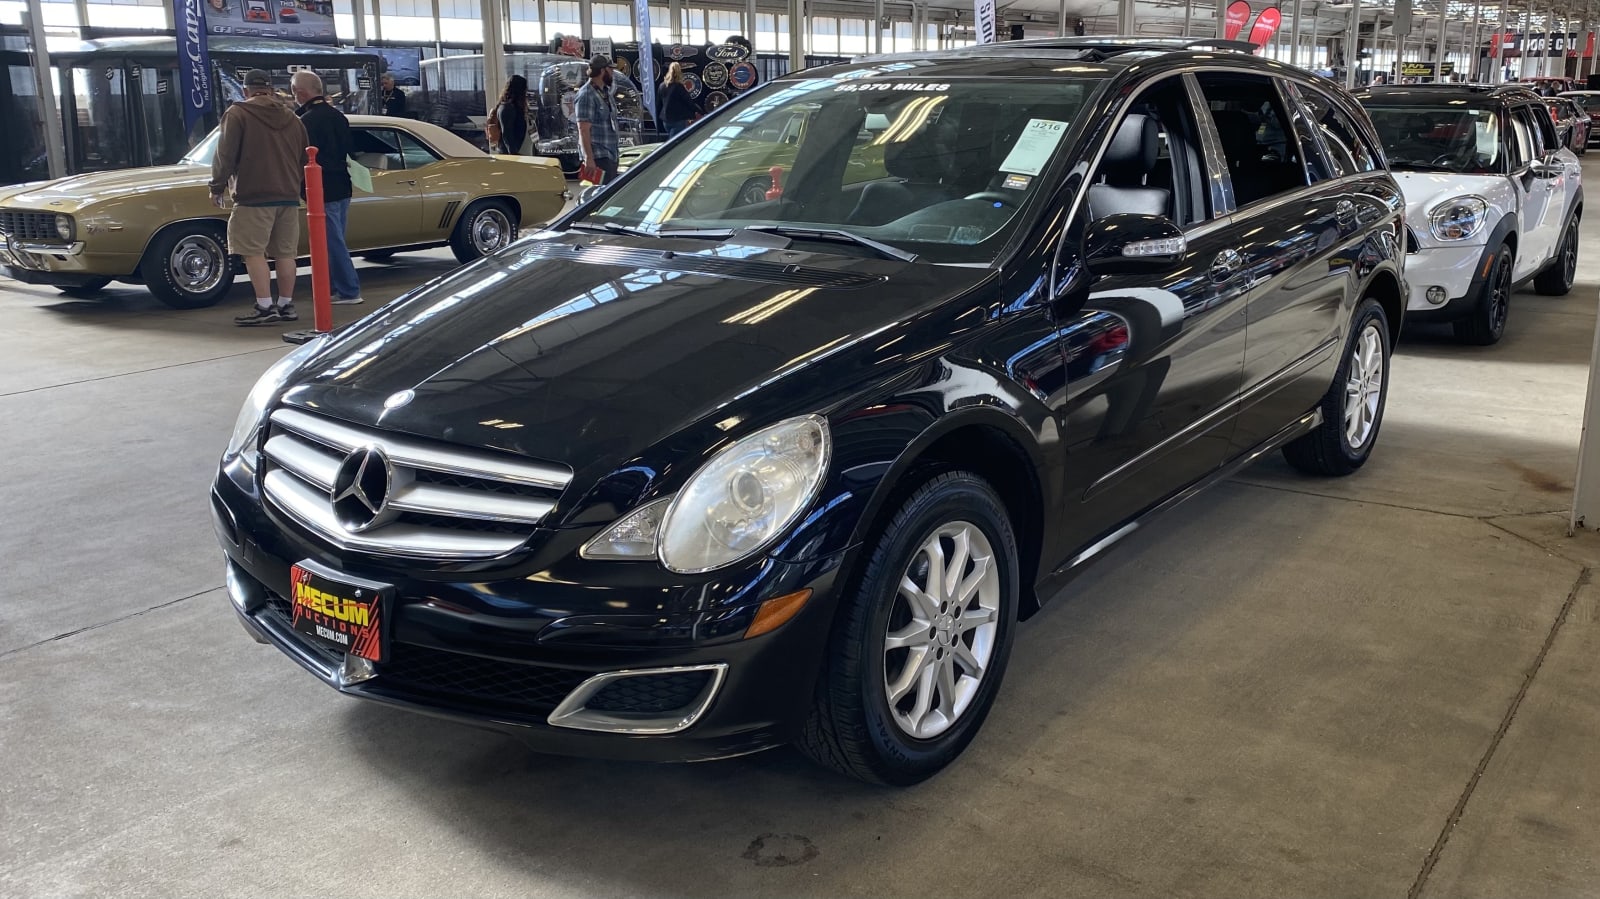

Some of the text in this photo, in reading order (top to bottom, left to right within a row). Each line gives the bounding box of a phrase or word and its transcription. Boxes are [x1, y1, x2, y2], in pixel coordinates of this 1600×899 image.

[715, 47, 738, 57] Ford
[892, 83, 951, 91] MILES
[1032, 122, 1061, 131] J216
[296, 582, 369, 626] MECUM
[297, 605, 370, 639] AUCTIONS
[316, 625, 348, 645] MECUM.COM
